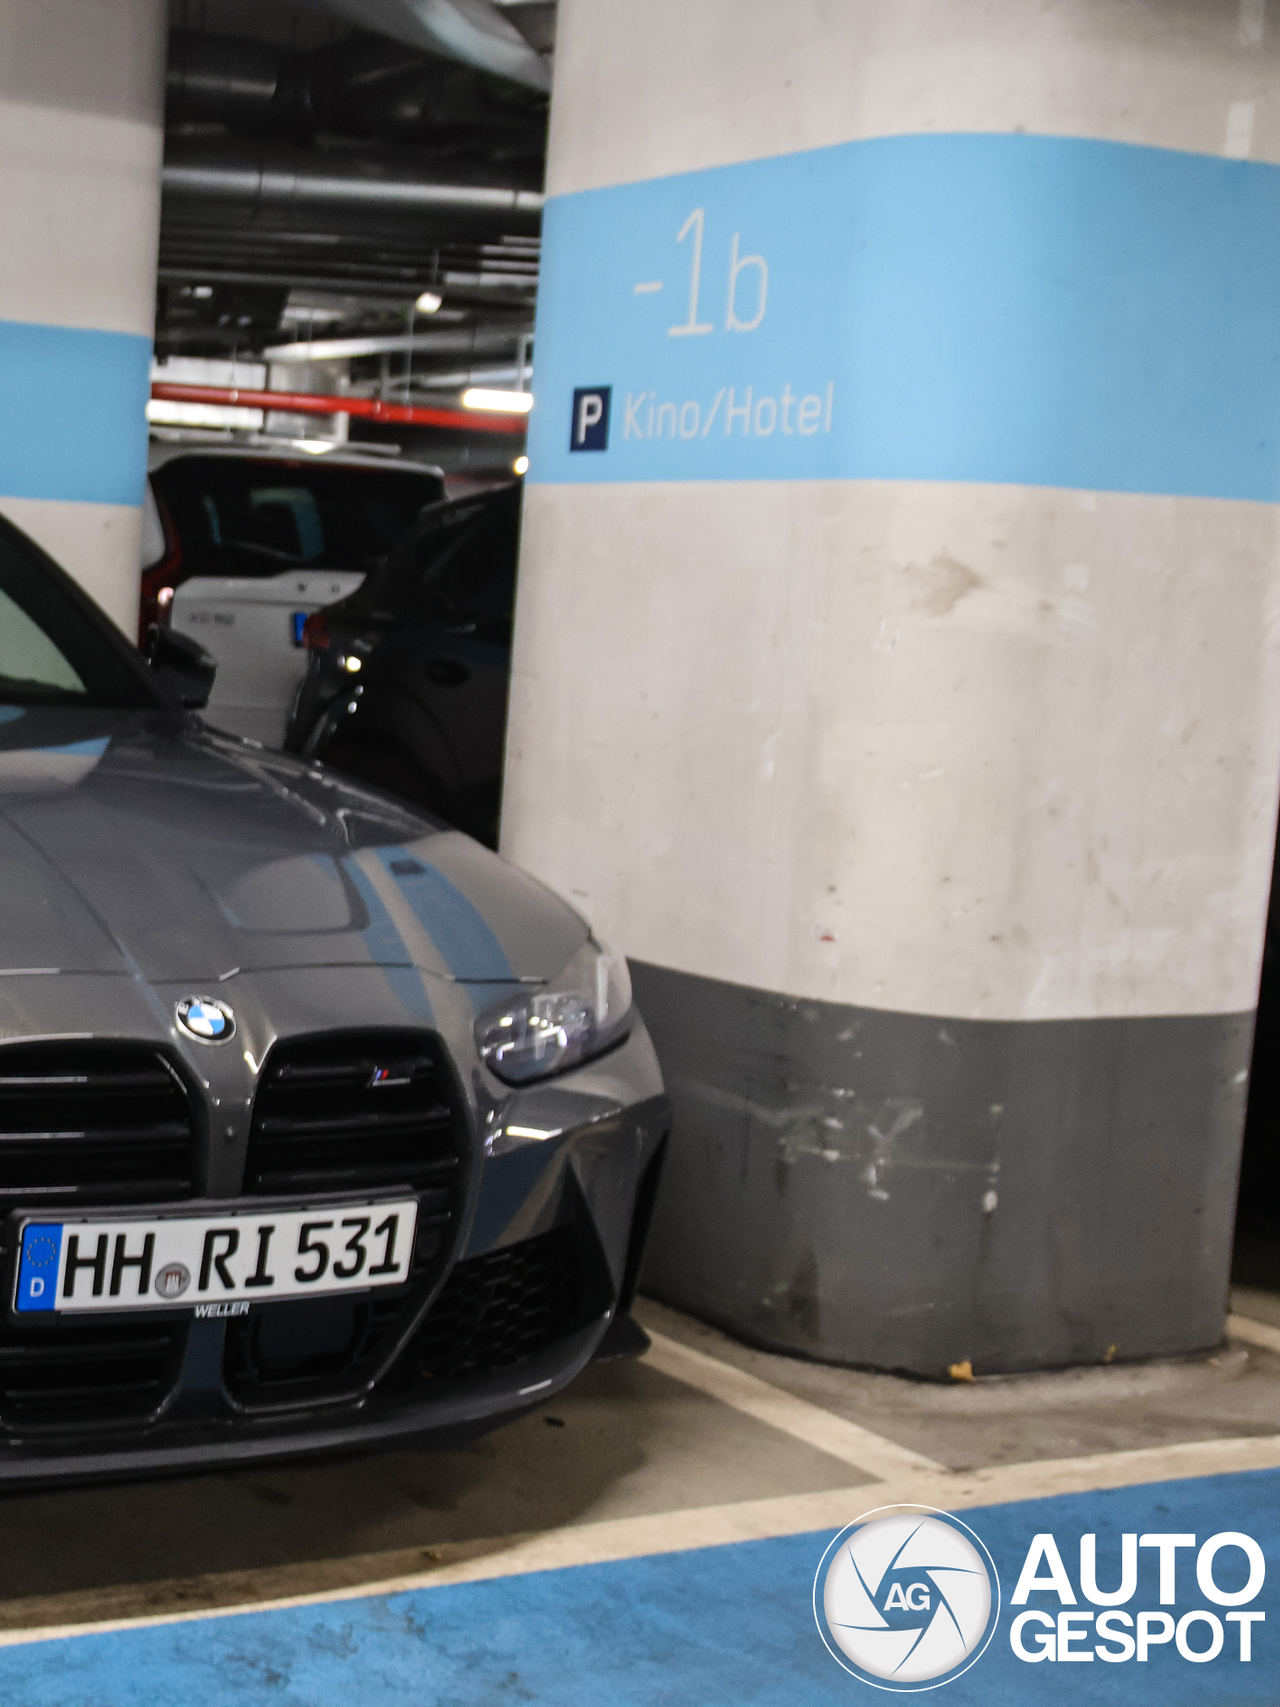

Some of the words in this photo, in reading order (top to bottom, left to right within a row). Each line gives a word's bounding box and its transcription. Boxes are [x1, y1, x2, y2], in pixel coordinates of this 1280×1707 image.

[634, 207, 770, 337] -1b
[578, 394, 604, 445] P
[623, 380, 835, 440] Kino/Hotel
[29, 1277, 45, 1298] D
[62, 1232, 156, 1298] HH
[197, 1225, 276, 1292] RI
[293, 1214, 401, 1283] 531
[194, 1301, 251, 1319] WELLER
